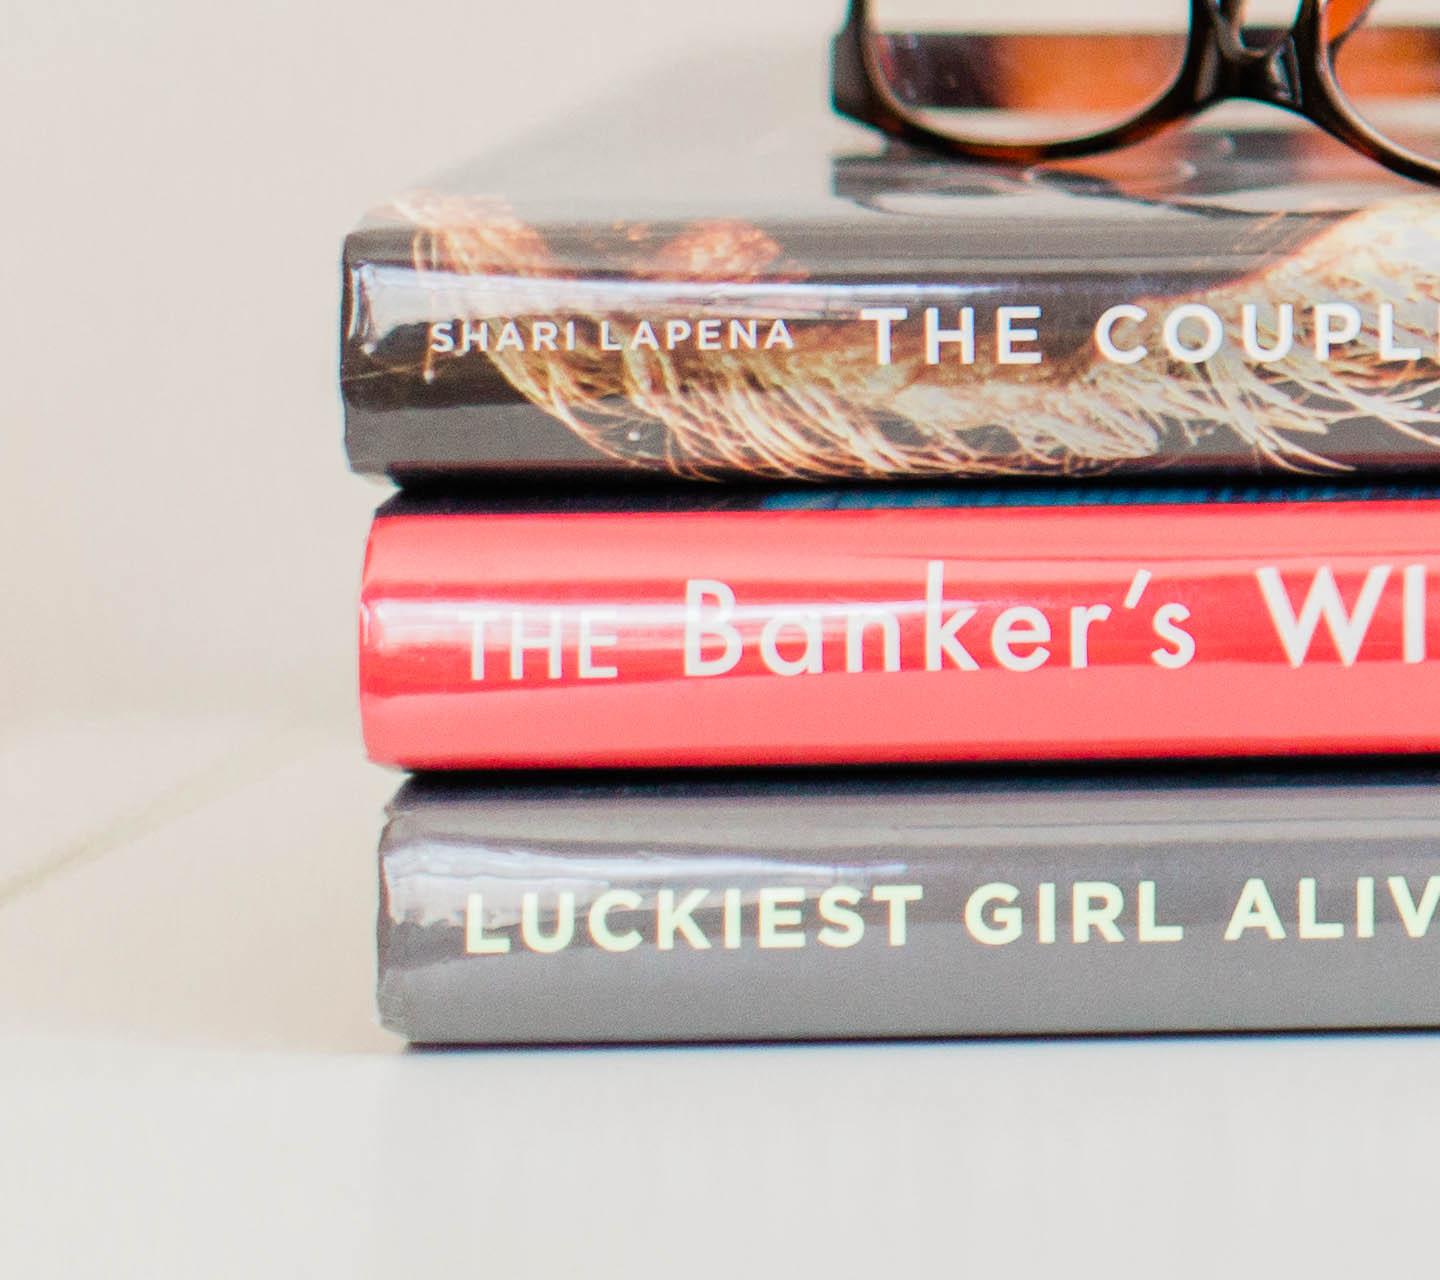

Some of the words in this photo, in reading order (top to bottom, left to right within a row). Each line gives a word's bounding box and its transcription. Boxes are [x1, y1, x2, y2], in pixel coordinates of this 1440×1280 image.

[430, 320, 577, 352] SHARI
[601, 318, 795, 351] LAPENA
[859, 305, 1041, 365] THE
[459, 610, 617, 681] THE
[465, 885, 922, 956] LUCKIEST
[964, 879, 1183, 945] GIRL
